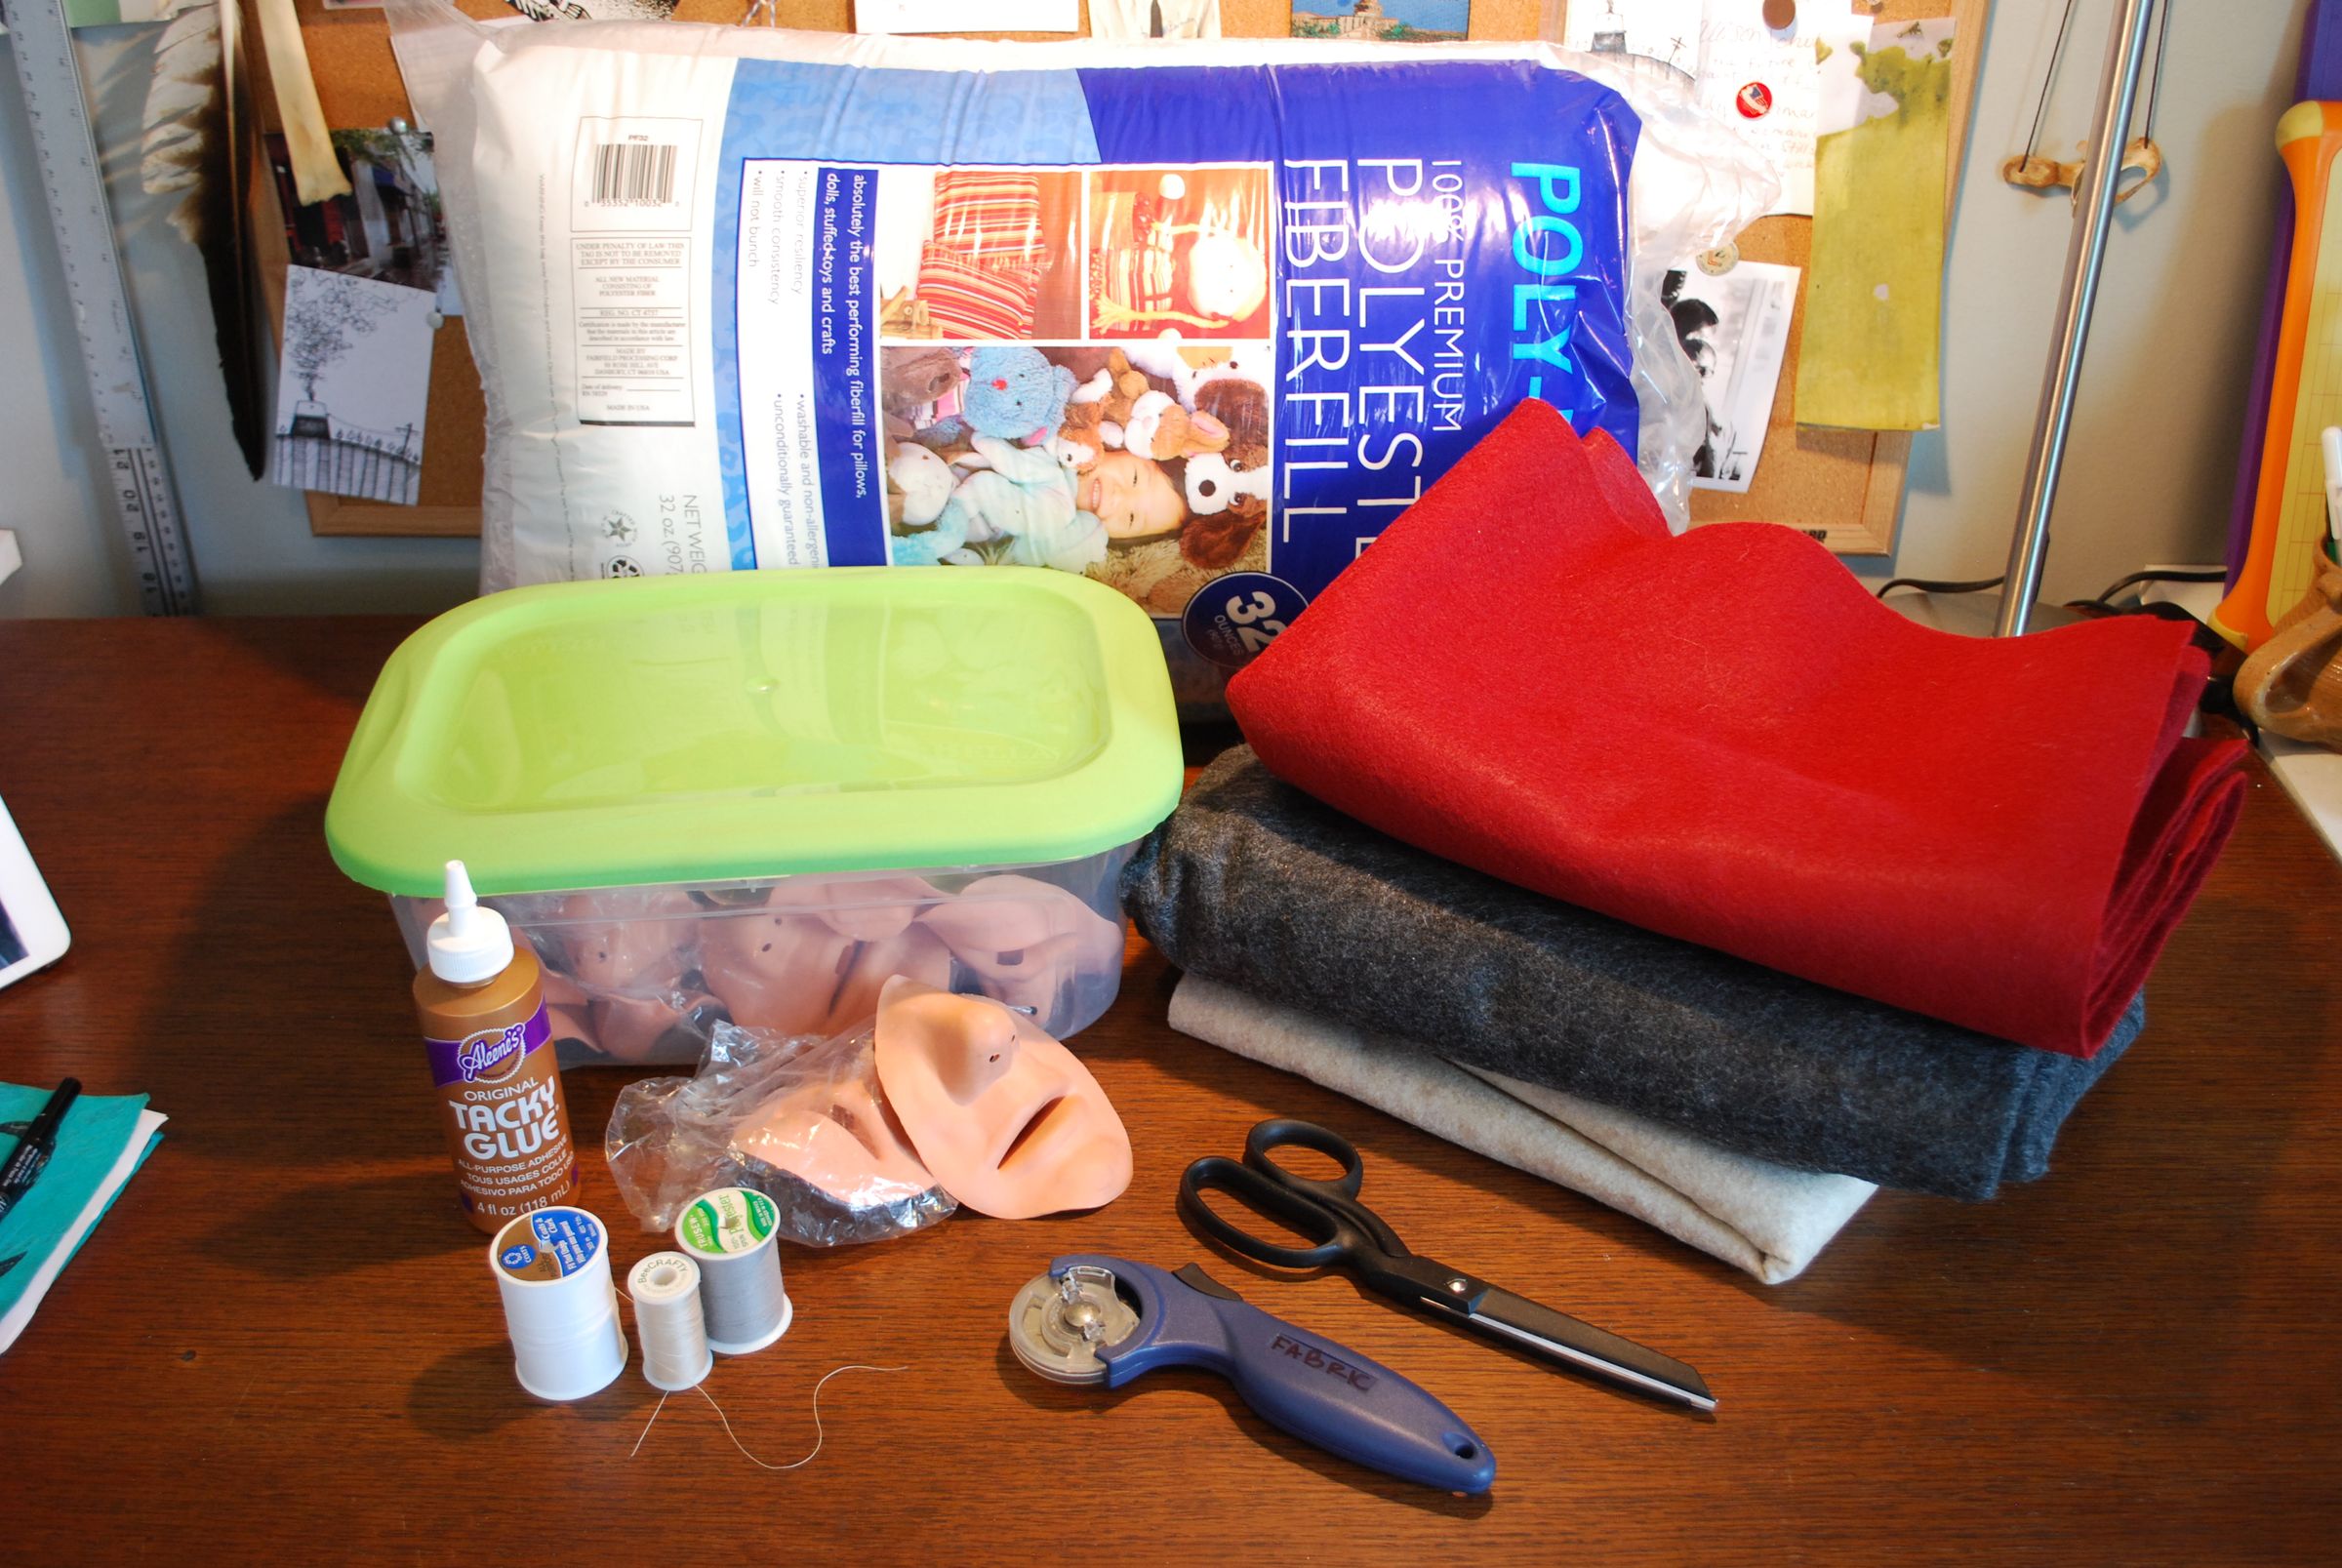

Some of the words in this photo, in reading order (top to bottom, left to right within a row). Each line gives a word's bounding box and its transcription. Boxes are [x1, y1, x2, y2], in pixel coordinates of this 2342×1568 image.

[751, 177, 765, 197] will
[772, 176, 786, 223] smooth
[795, 177, 808, 227] superior
[823, 173, 840, 205] dolls,
[846, 174, 867, 237] absolutely
[749, 200, 761, 222] not
[747, 225, 760, 267] bunch
[767, 227, 782, 305] consistency
[790, 233, 807, 297] resiliency
[849, 240, 865, 262] the
[848, 265, 863, 297] best
[1511, 162, 1584, 423] POLY-
[821, 295, 833, 318] and
[821, 321, 835, 354] crafts
[845, 299, 861, 377] performing
[1283, 159, 1350, 543] FIBERFILL
[1355, 158, 1425, 559] POLYEST
[1433, 259, 1465, 431] PREMIUM
[850, 379, 865, 426] fiberfill
[773, 399, 793, 497] unconditionally
[796, 399, 812, 459] washable
[852, 429, 864, 449] for
[800, 462, 815, 486] and
[852, 453, 868, 499] pillows,
[659, 494, 676, 513] 32
[682, 494, 702, 530] NET
[778, 498, 801, 566] guaranteed
[661, 540, 684, 576] (907
[1214, 614, 1245, 657] OUNCES
[1226, 590, 1286, 653] 32
[461, 1025, 524, 1079] Aleene's
[448, 1075, 555, 1132] TACKY
[464, 1076, 539, 1102] ORIGINAL
[458, 1158, 526, 1174] ALL-PURPOSE
[528, 1133, 568, 1168] ADHESIVE
[464, 1110, 559, 1159] GLUE
[460, 1179, 506, 1196] ADHESIVO
[508, 1184, 537, 1196] PARA
[537, 1168, 564, 1187] TODO
[466, 1173, 493, 1186] TOUS
[495, 1171, 541, 1186] USAGES
[542, 1148, 568, 1175] COLLE
[477, 1201, 485, 1213] 4
[488, 1202, 497, 1216] fl
[500, 1206, 516, 1217] oz
[519, 1195, 548, 1215] (118
[550, 1179, 572, 1204] mL)
[637, 1258, 688, 1284] BeeCRAFTY
[1271, 1334, 1372, 1391] FABRIC
